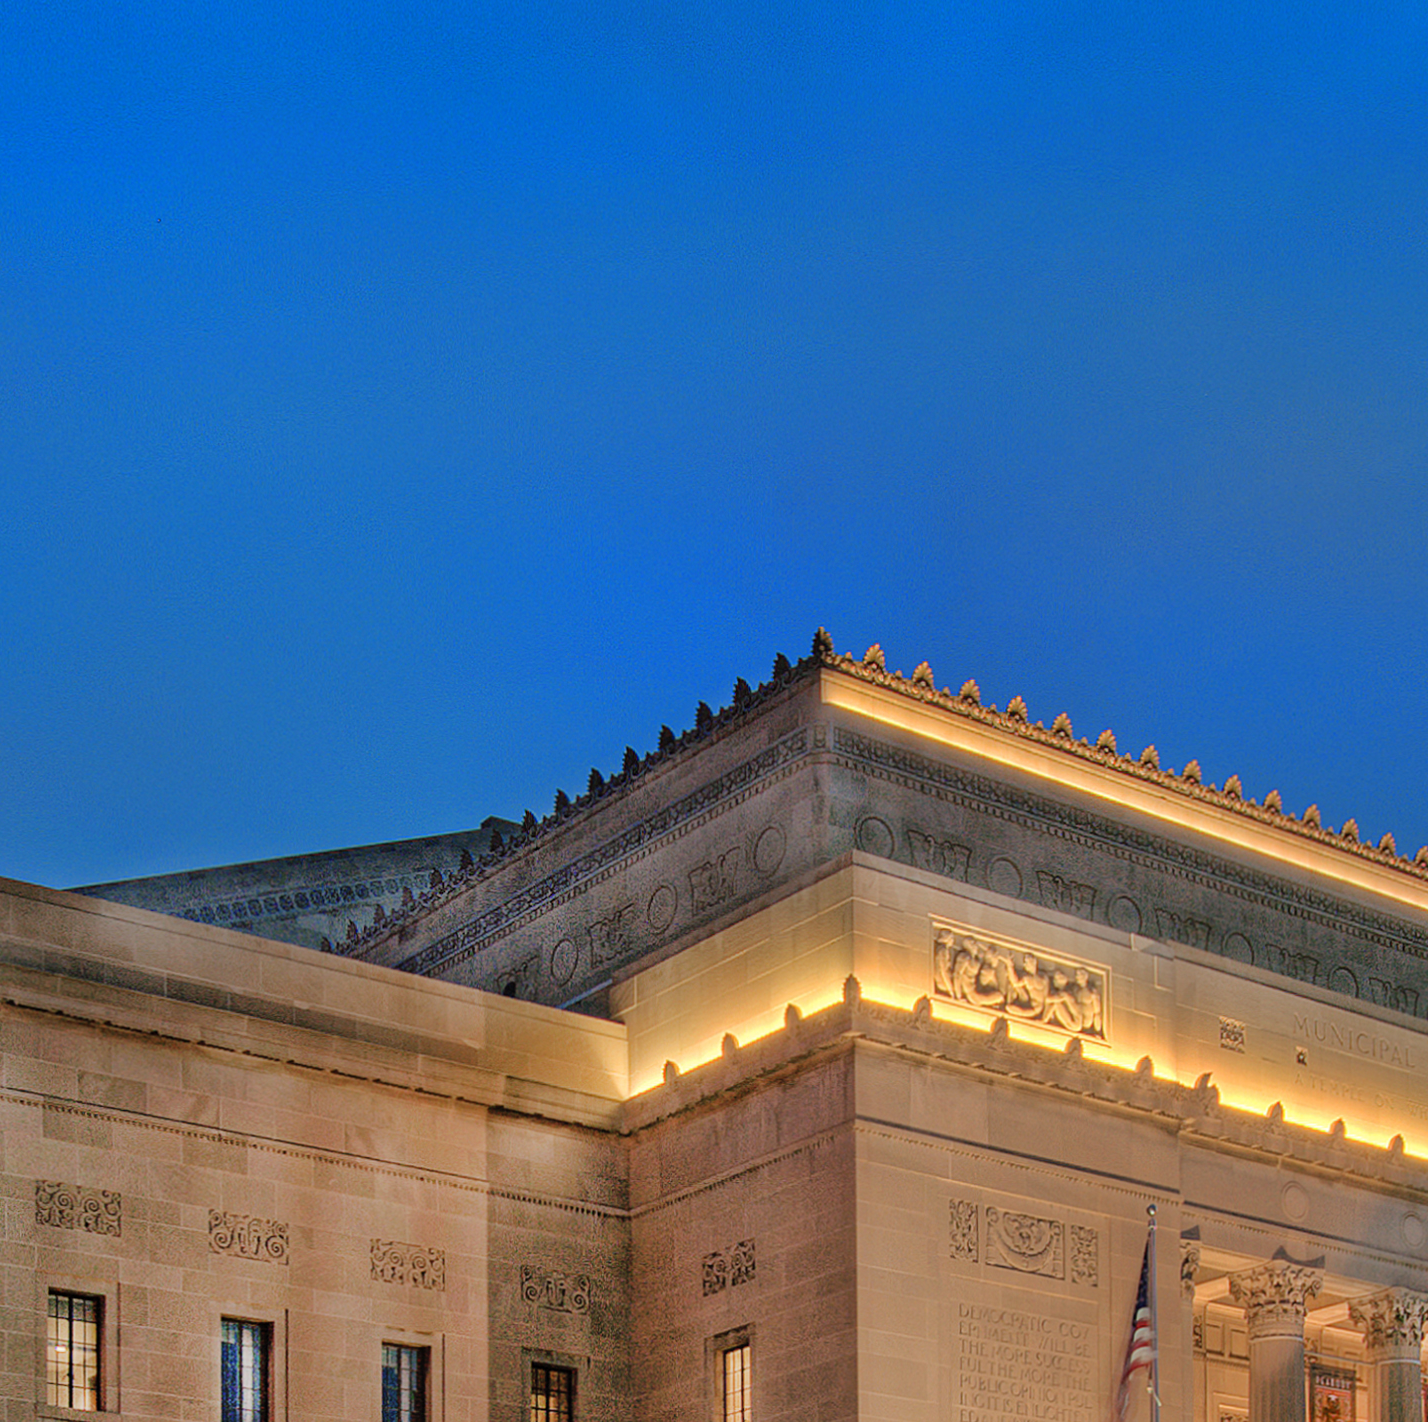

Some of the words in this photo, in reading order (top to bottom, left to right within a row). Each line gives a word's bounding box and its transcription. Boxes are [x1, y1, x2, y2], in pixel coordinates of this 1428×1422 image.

[1293, 1012, 1415, 1068] MUNICIPAL
[1310, 1074, 1365, 1103] TEMPLE
[1374, 1092, 1394, 1110] ON
[959, 1302, 1052, 1334] DEMOCRATIC
[959, 1338, 988, 1357] THE
[991, 1345, 1032, 1365] MORE
[1035, 1352, 1091, 1374] SUCCESS
[1074, 1342, 1091, 1358] BE
[959, 1356, 986, 1374] FUL
[987, 1360, 1017, 1379] THE
[1020, 1367, 1060, 1388] MORE
[1062, 1373, 1091, 1392] THE
[959, 1373, 1008, 1395] PUBLIC
[1002, 1399, 1013, 1414] IS
